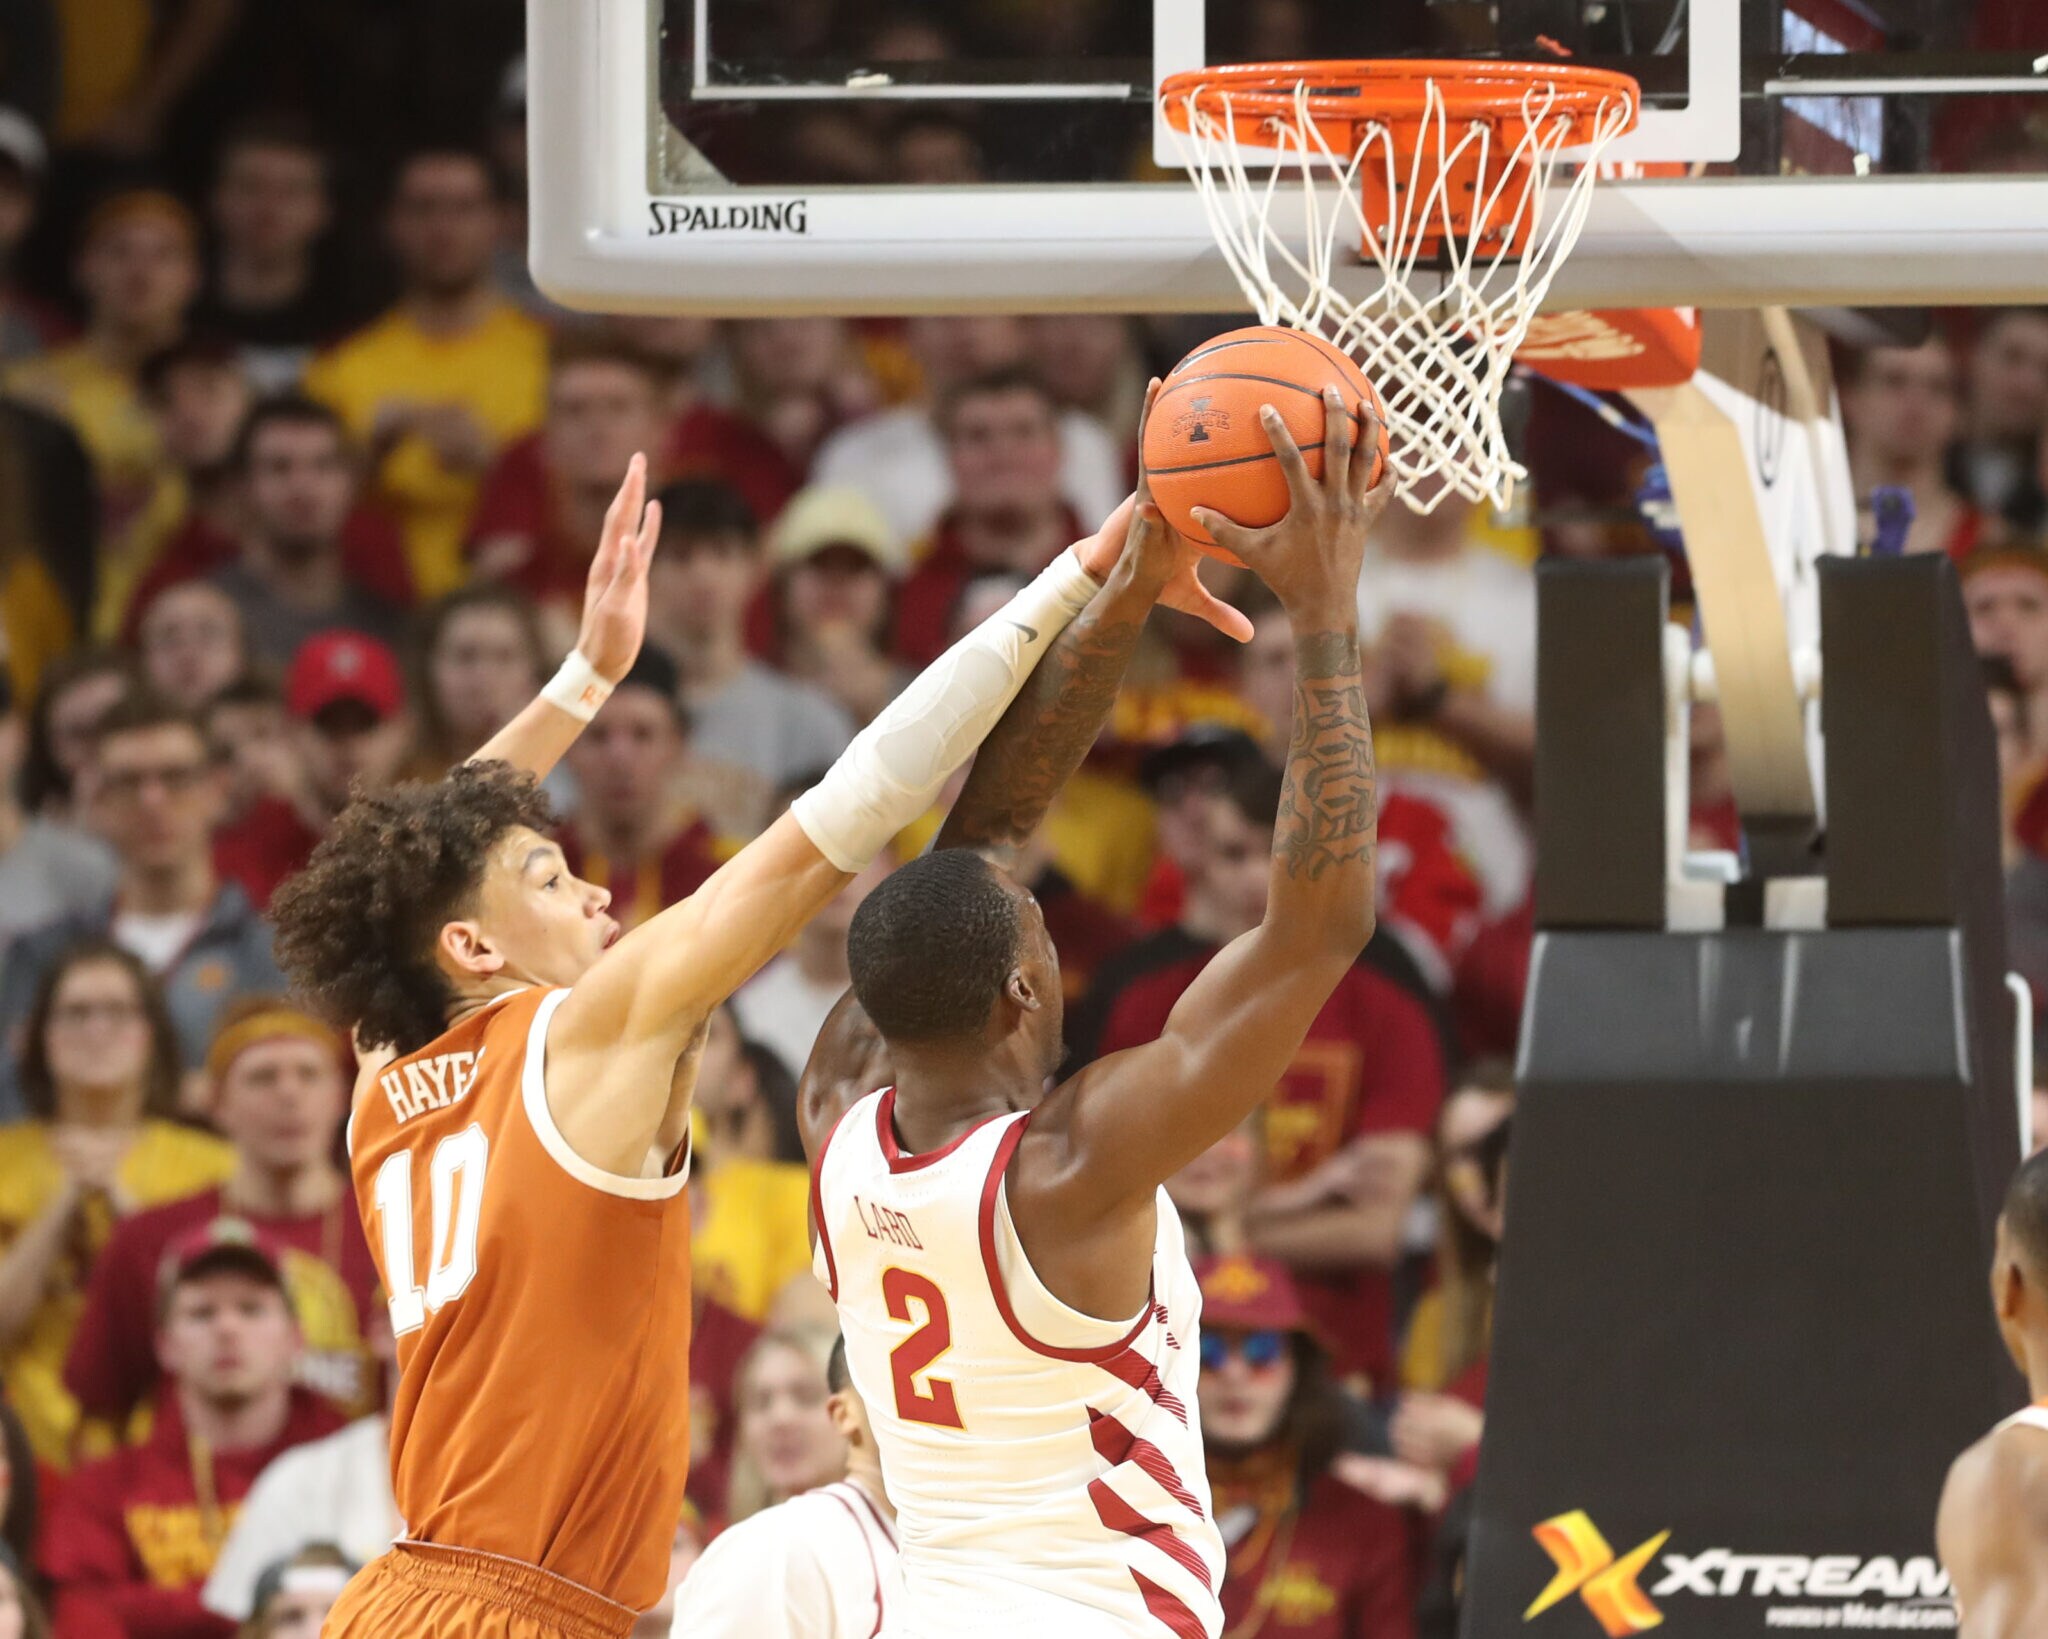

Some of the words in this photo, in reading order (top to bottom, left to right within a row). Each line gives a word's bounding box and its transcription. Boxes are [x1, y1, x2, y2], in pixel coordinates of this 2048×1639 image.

[648, 200, 806, 236] SPALDING
[374, 1121, 489, 1338] 10
[853, 1195, 924, 1251] LARD
[882, 1265, 967, 1433] 2
